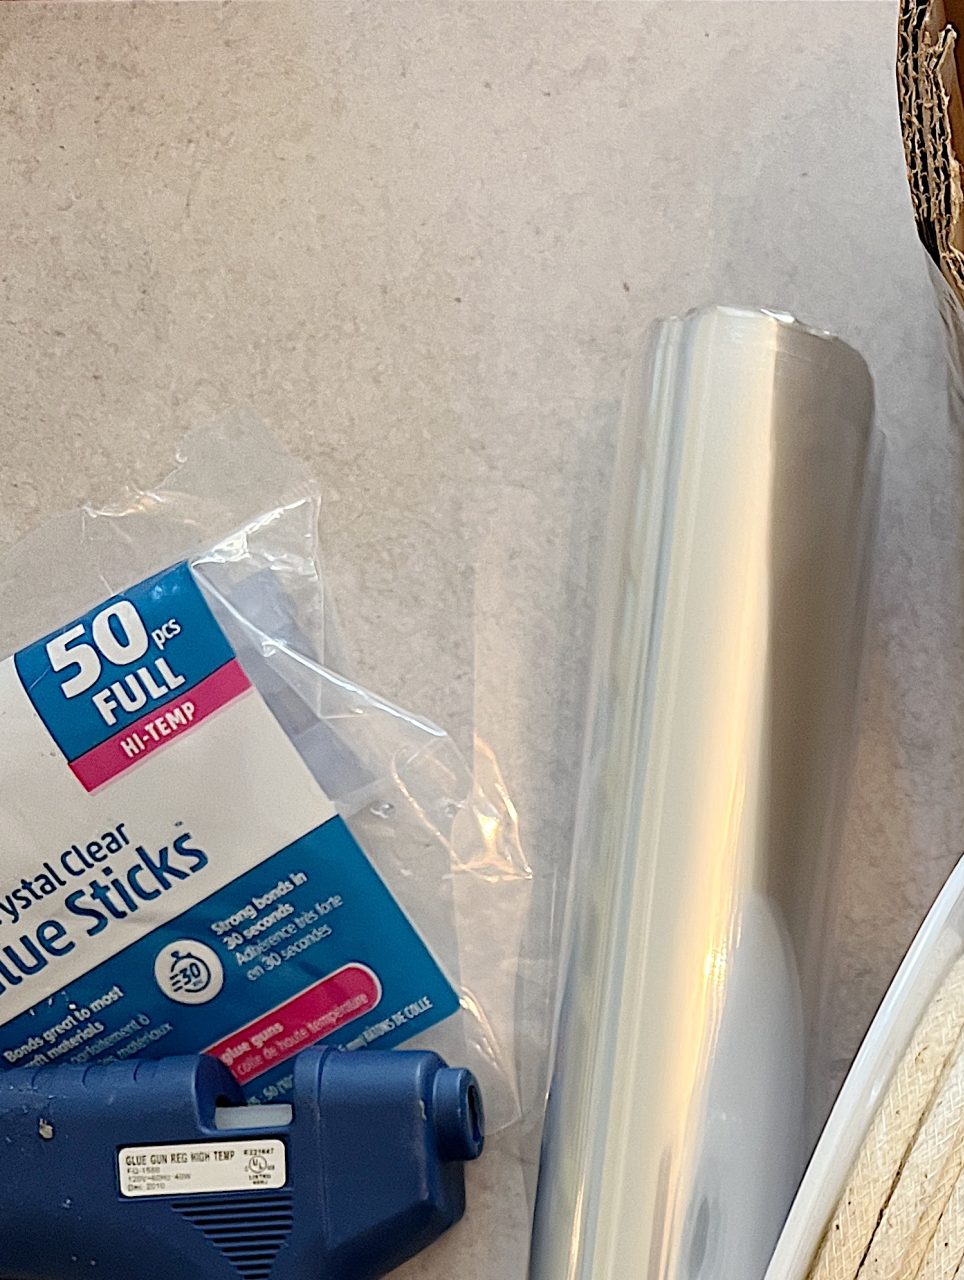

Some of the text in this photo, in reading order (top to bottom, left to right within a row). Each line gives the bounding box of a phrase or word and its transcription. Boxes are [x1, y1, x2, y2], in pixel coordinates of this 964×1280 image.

[46, 599, 181, 699] 50 pcs
[92, 657, 186, 726] FULL
[119, 701, 197, 758] HI-TEMP
[0, 822, 130, 925] ystal Clear
[0, 832, 209, 995] lue Sticks
[211, 871, 308, 935] Strong bonds in
[223, 904, 295, 950] 30 seconds
[261, 952, 282, 971] 30
[280, 923, 332, 961] secondes
[178, 962, 201, 986] 30
[3, 984, 124, 1063] Bonds great to most
[403, 996, 434, 1019] COLLE
[47, 1021, 105, 1060] materials
[251, 1021, 285, 1049] guns
[125, 1150, 235, 1166] GLUE GUN REG HIGH TEMP
